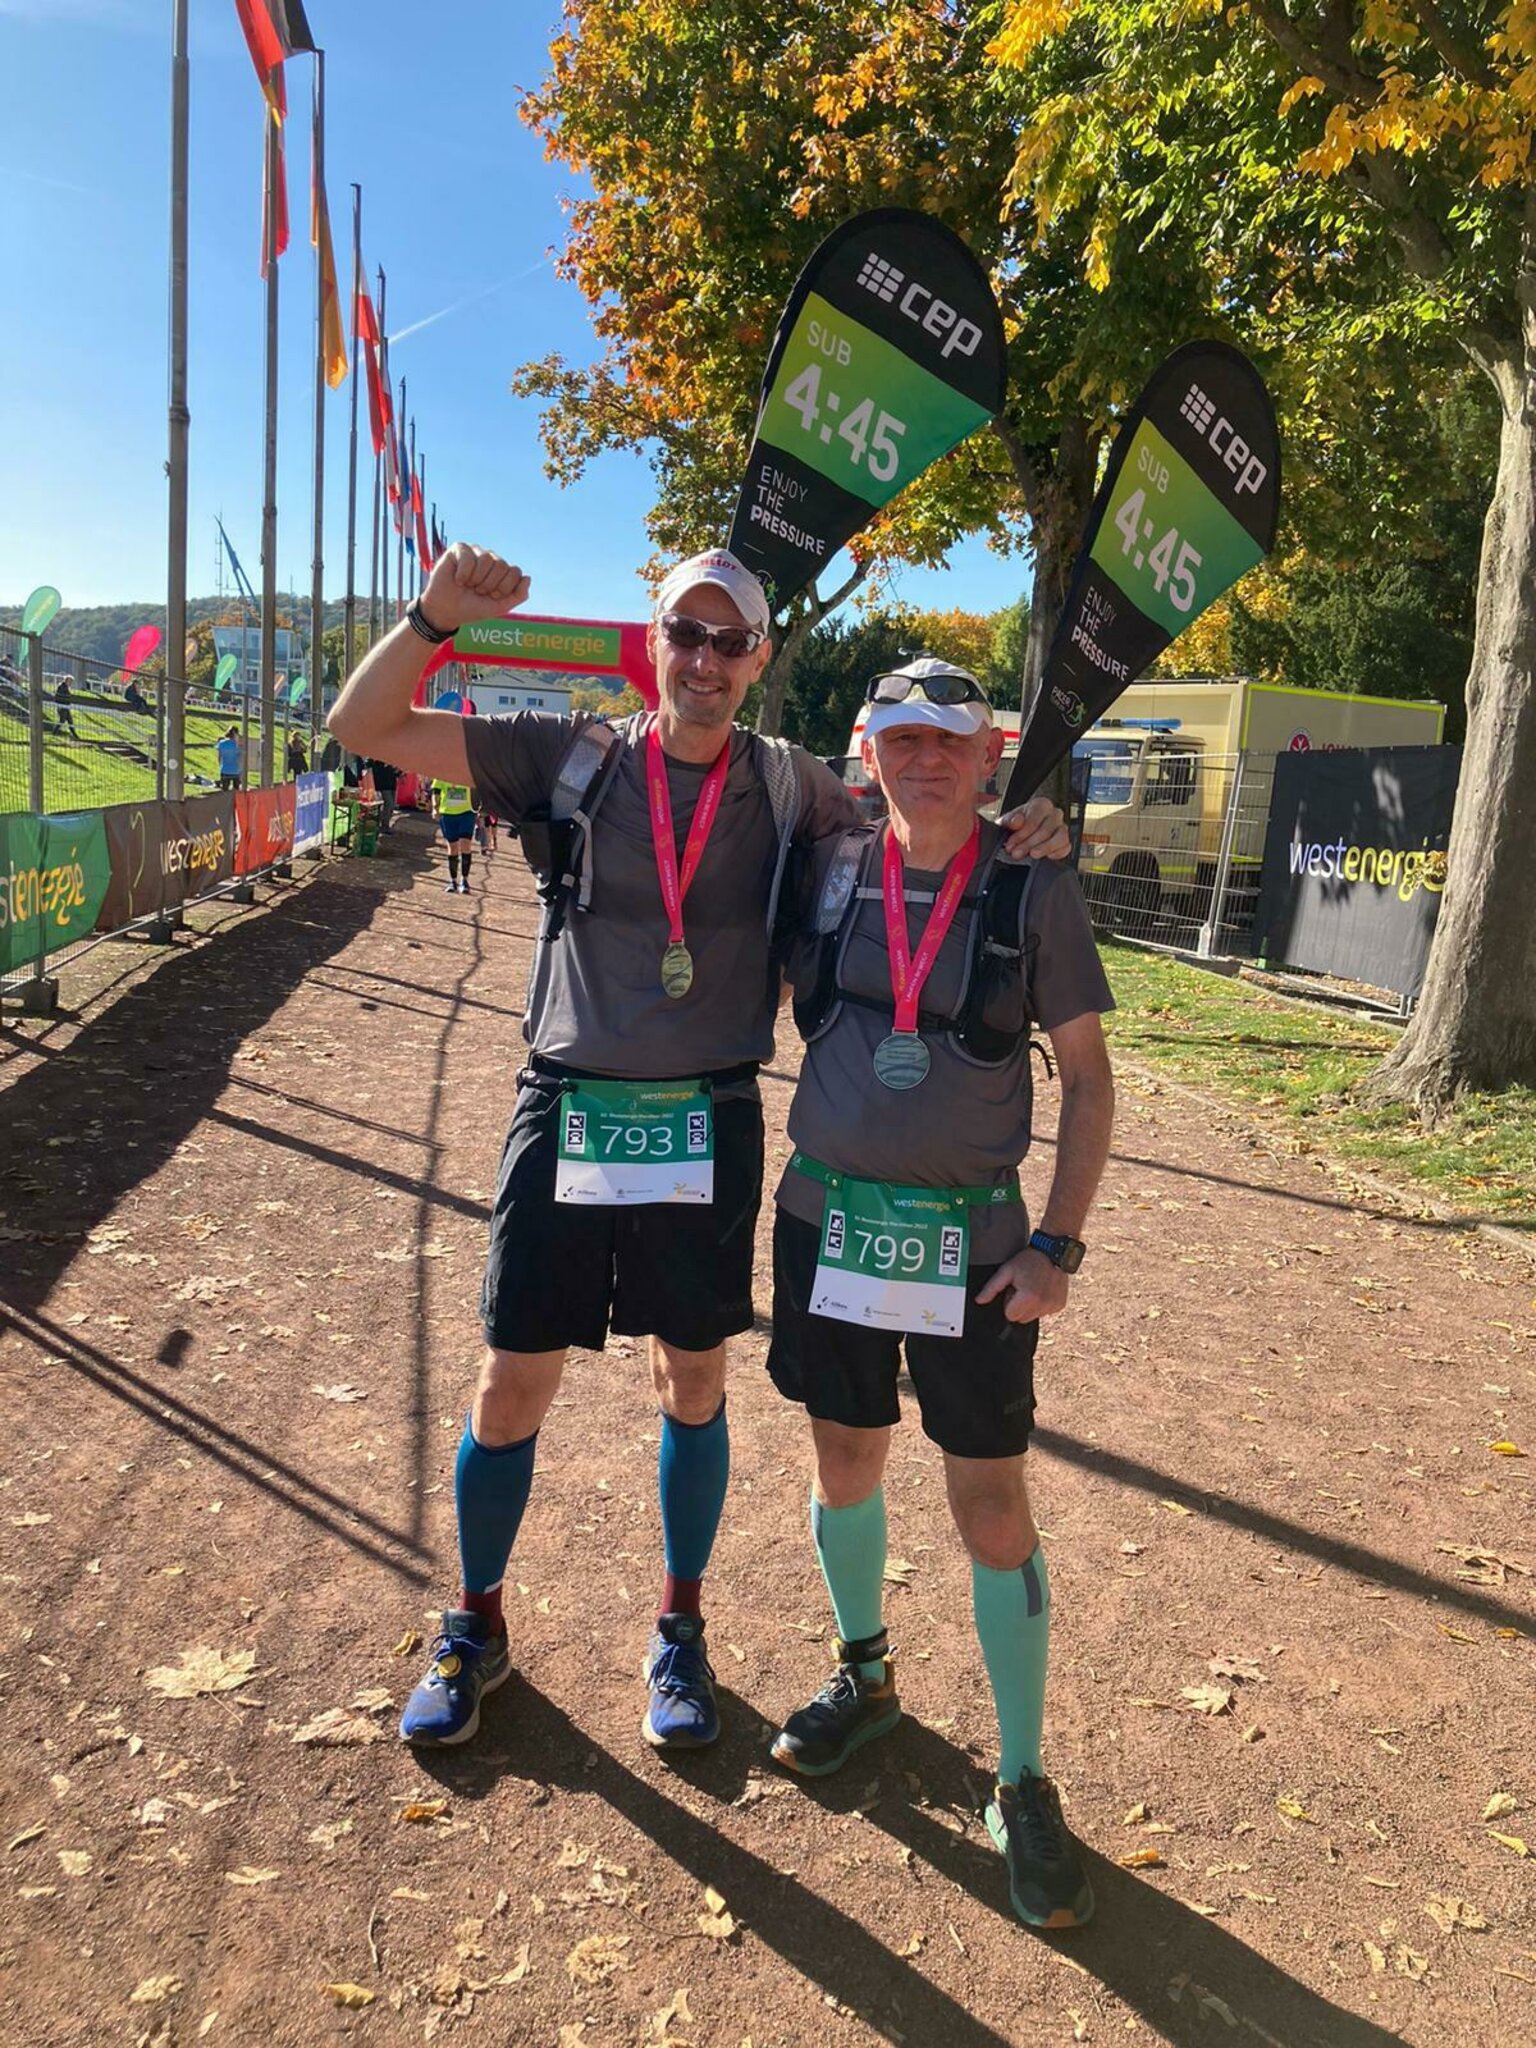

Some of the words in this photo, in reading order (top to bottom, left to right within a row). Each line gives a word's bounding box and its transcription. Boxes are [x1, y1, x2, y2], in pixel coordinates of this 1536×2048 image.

[806, 320, 852, 366] SUB
[900, 282, 983, 359] cep
[783, 363, 907, 482] 4:45
[1137, 445, 1170, 494] SUB
[1208, 416, 1268, 495] cep
[756, 484, 785, 514] THE
[760, 465, 809, 502] ENJOY
[750, 504, 826, 556] PRESSURE
[1114, 488, 1203, 612] 4:45
[1079, 606, 1101, 637] THE
[1085, 585, 1117, 627] ENJOY
[470, 627, 606, 657] westenergie
[1071, 625, 1130, 682] PRESSURE
[600, 1125, 674, 1156] 793
[855, 1230, 926, 1273] 799
